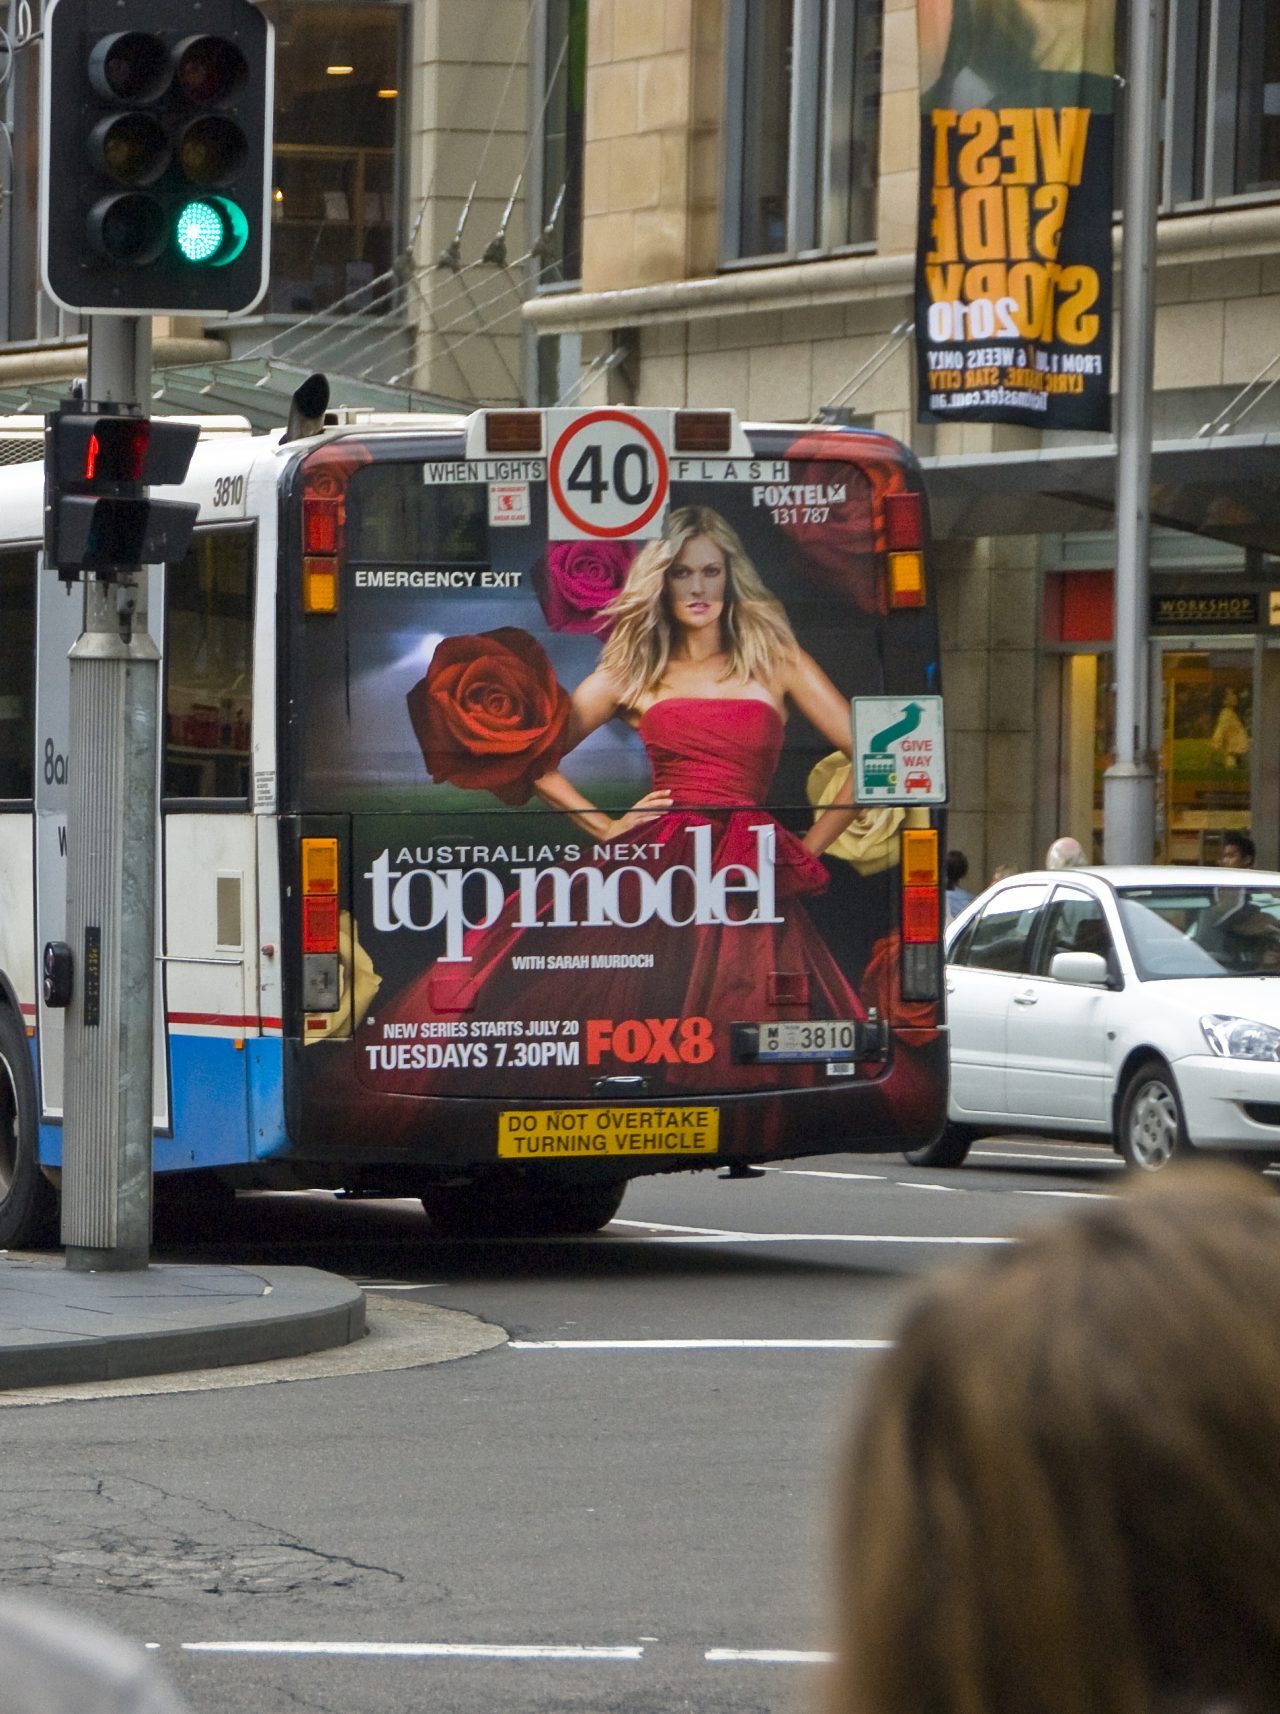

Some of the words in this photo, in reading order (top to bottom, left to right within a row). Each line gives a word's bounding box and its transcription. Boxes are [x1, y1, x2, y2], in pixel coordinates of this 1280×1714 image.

[428, 463, 479, 481] WHEN
[485, 461, 542, 480] LIGHTS
[678, 461, 786, 480] FLASH
[567, 443, 652, 505] 40
[213, 475, 243, 507] 3810
[752, 484, 828, 507] FOXTEL
[771, 508, 799, 525] 131
[802, 506, 830, 525] 787
[355, 571, 475, 588] EMERGENCY
[481, 572, 522, 588] EXIT
[1161, 598, 1251, 611] WORKSHOP
[901, 740, 933, 752] GIVE
[903, 755, 932, 767] WAY
[395, 845, 581, 864] AUSTRALIA'S
[593, 843, 665, 861] NEXT
[363, 848, 505, 963] top
[510, 823, 785, 929] model
[512, 956, 545, 970] WITH
[547, 955, 589, 969] SARAH
[591, 954, 654, 969] MURDOCH
[384, 1023, 418, 1039] NEW
[420, 1022, 468, 1038] SERIES
[470, 1021, 523, 1037] STARTS
[525, 1020, 560, 1036] JULY
[562, 1020, 580, 1035] 20
[801, 1026, 853, 1049] 3810
[586, 1016, 715, 1066] FOX8
[366, 1043, 488, 1070] TUESDAYS
[494, 1041, 580, 1068] 7.30PM
[508, 1115, 537, 1132] DO
[547, 1114, 588, 1131] NOT
[596, 1111, 709, 1130] OVERTAKE
[514, 1135, 606, 1153] TURNING
[615, 1132, 705, 1150] VEHICLE
